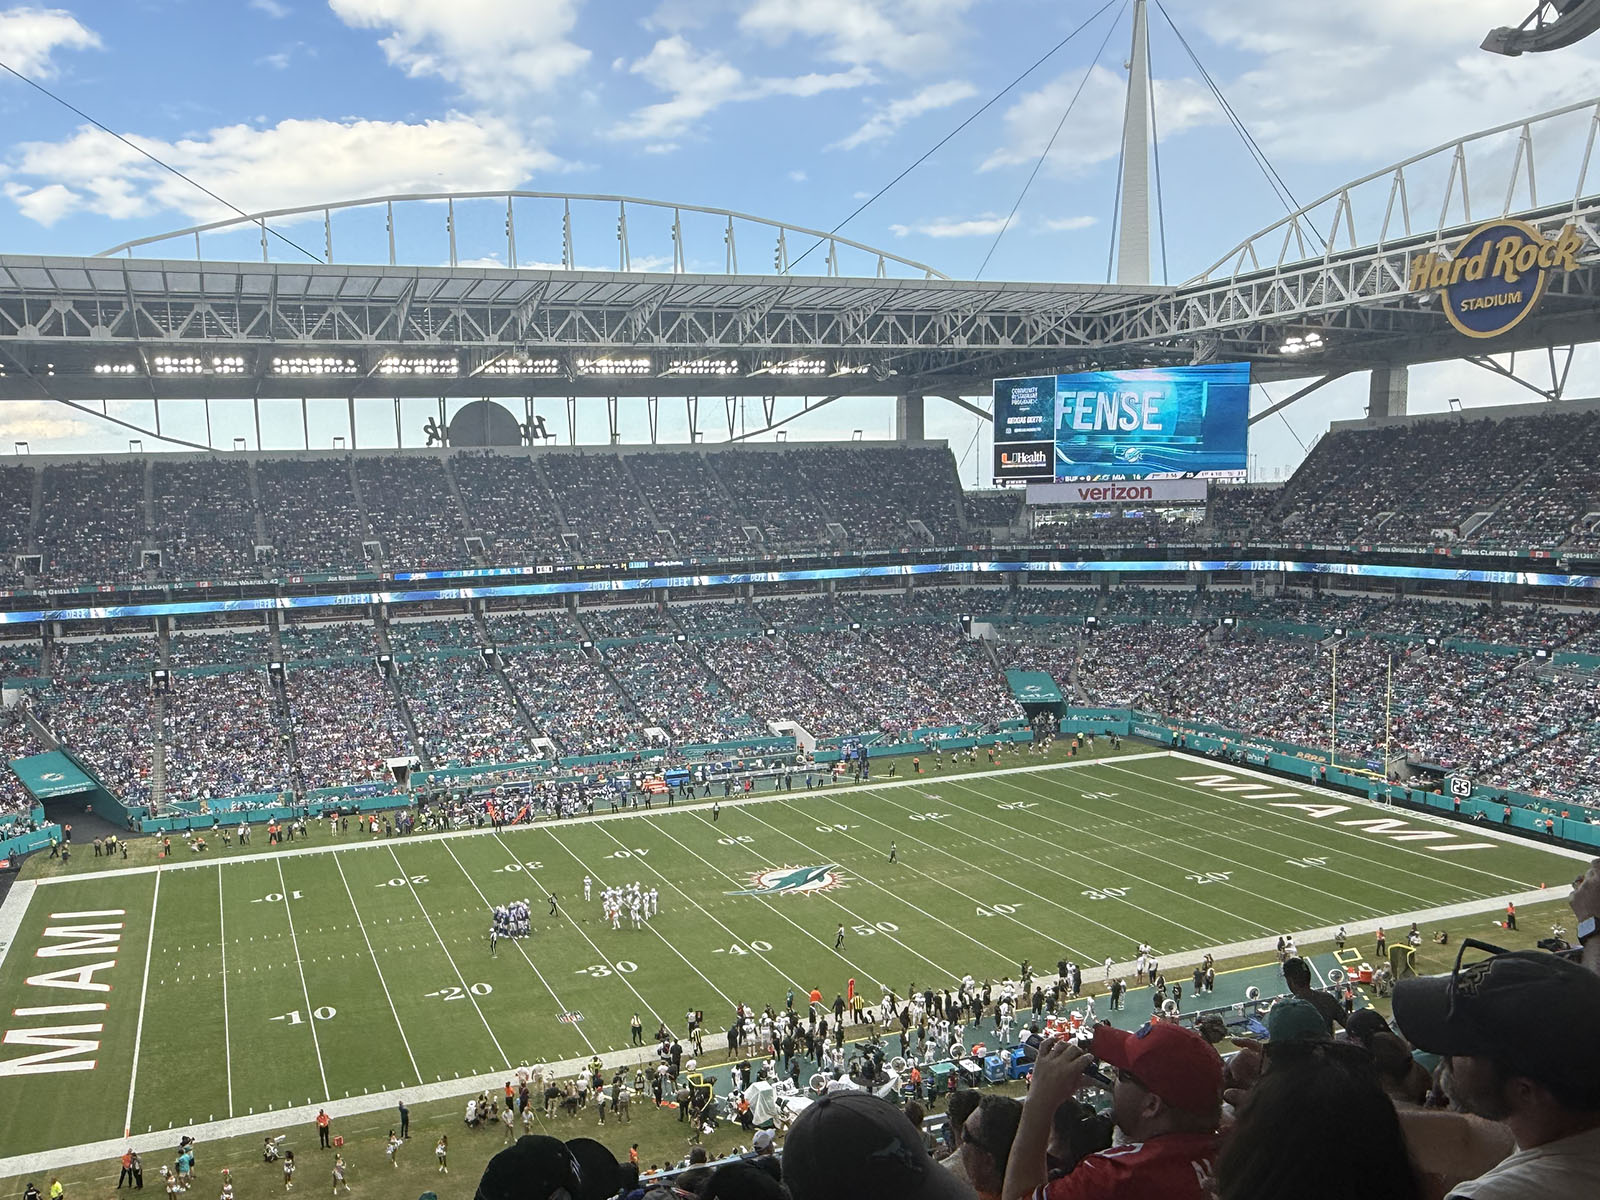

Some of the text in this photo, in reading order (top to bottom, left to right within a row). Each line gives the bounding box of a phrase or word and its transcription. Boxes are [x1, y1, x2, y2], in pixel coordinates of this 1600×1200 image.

[1410, 224, 1584, 291] Hard Rock
[1461, 291, 1522, 312] STADIUM
[1056, 391, 1166, 431] FENSE
[1078, 484, 1152, 500] verizon
[1176, 774, 1498, 851] MIAMI
[717, 835, 755, 846] 50
[504, 861, 544, 873] 30
[1285, 857, 1326, 869] 10
[388, 875, 430, 887] 20
[1185, 871, 1230, 884] 20
[265, 890, 304, 901] 10
[1081, 887, 1126, 900] 30
[976, 903, 1016, 917] 40
[851, 921, 899, 936] 50
[728, 940, 774, 956] 40
[587, 960, 639, 978] 30
[0, 909, 126, 1077] MIAMI
[443, 982, 493, 1001] 20
[286, 1006, 337, 1026] 10
